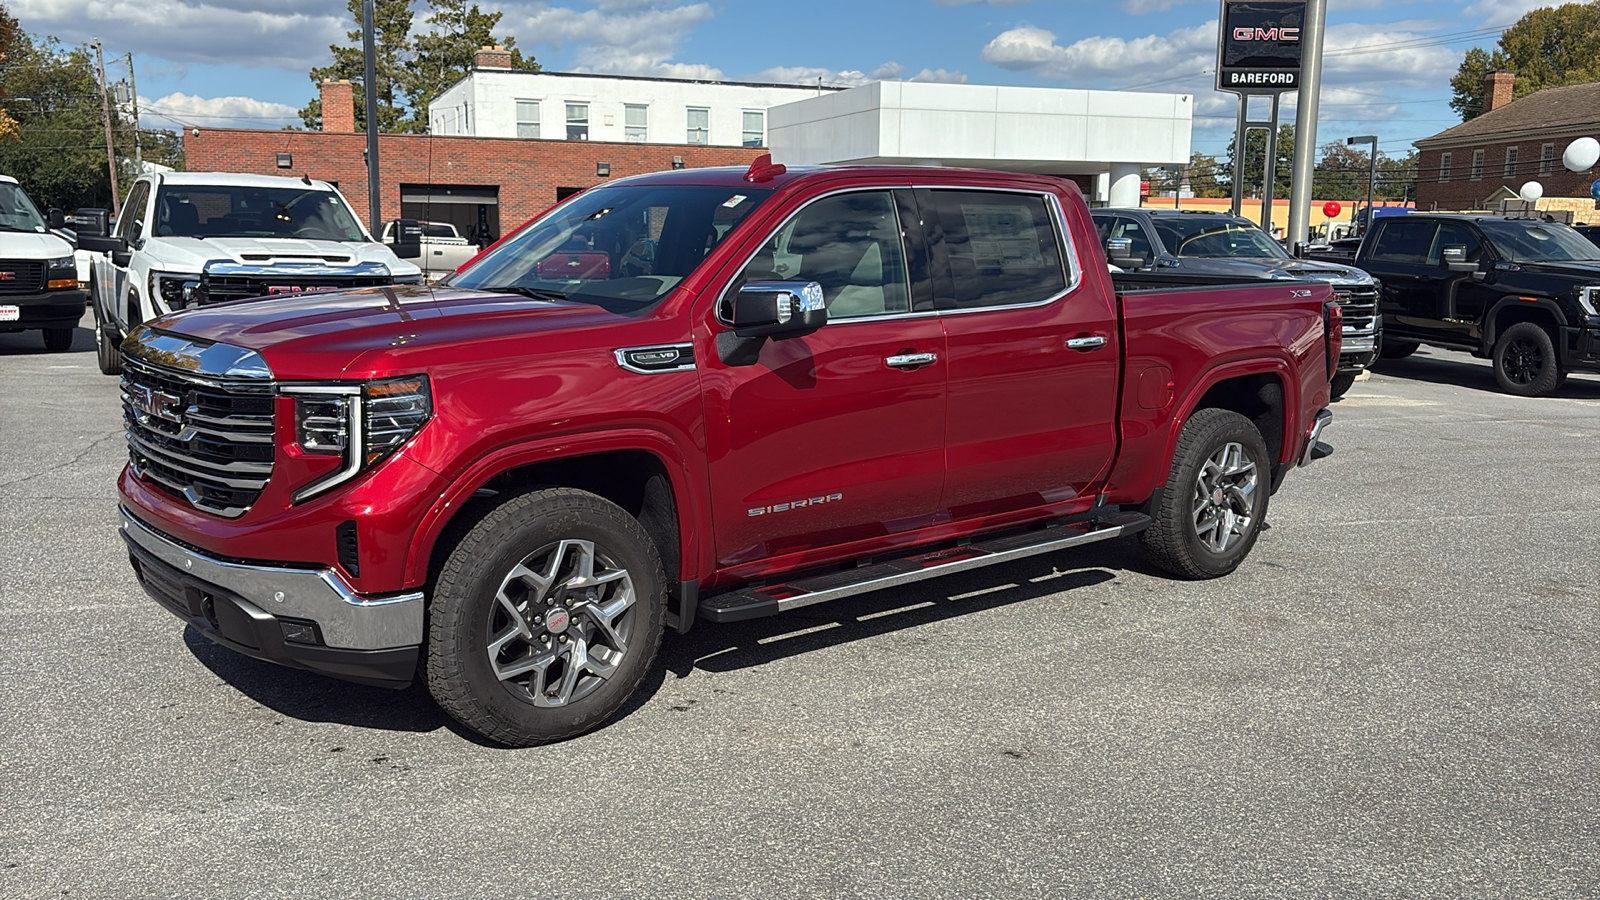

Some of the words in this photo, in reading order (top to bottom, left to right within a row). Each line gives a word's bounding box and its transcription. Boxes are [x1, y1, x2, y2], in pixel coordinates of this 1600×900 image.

[1233, 27, 1299, 41] GMC
[1231, 73, 1294, 83] BAREFORD
[131, 382, 181, 423] GMC
[748, 493, 842, 517] SIERRA
